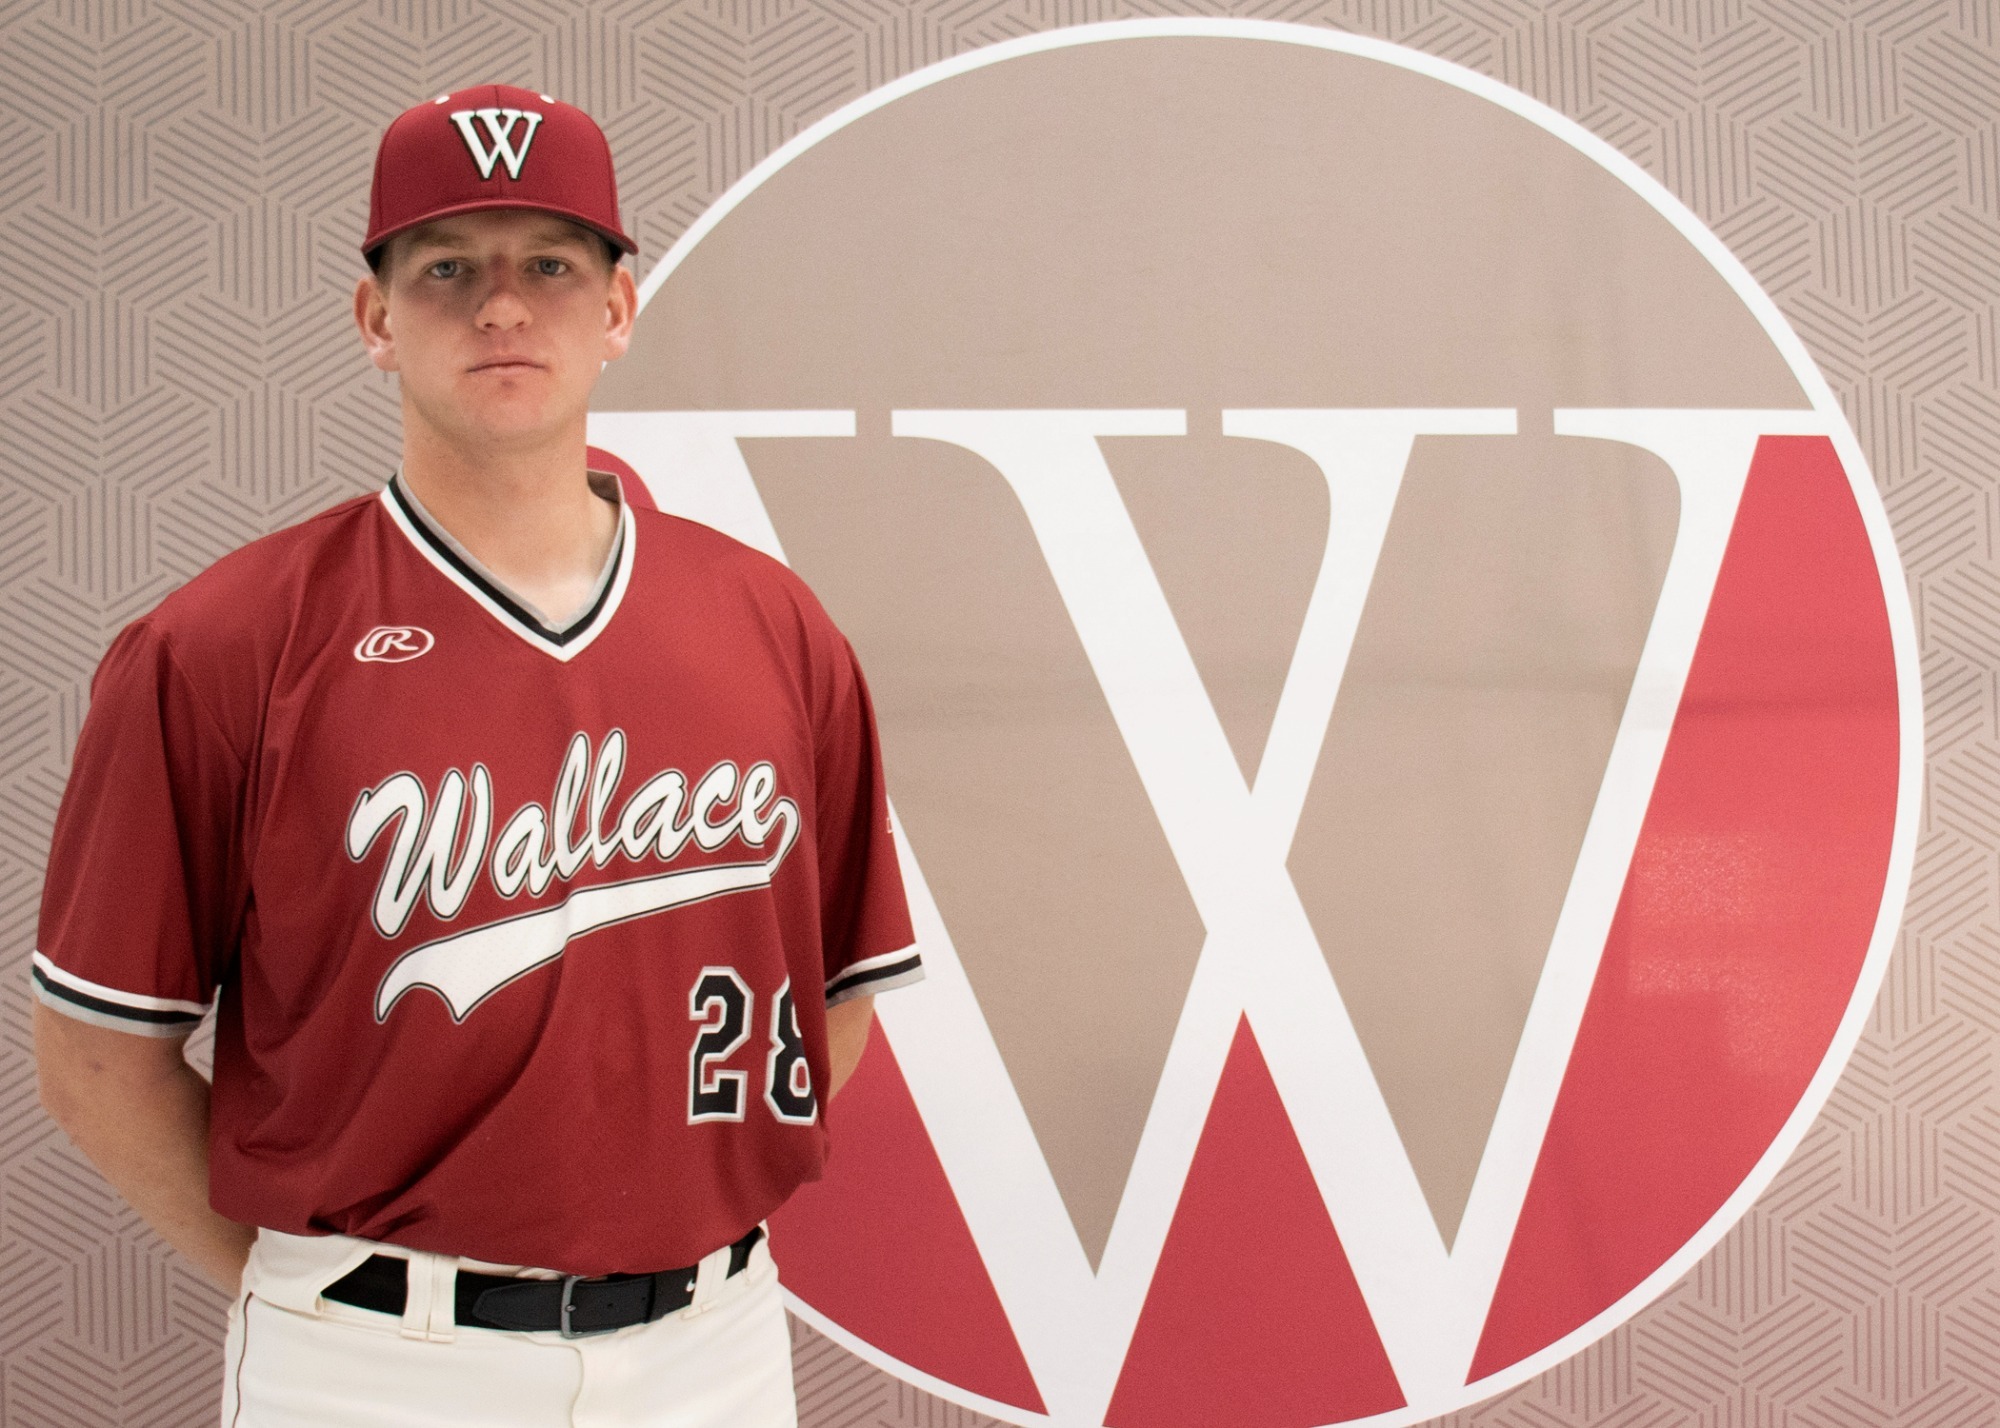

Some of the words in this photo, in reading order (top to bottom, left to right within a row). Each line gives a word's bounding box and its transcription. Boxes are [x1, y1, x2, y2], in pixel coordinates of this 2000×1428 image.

[450, 108, 543, 180] W
[364, 628, 420, 658] R
[346, 727, 800, 939] Wallace
[588, 408, 1832, 1428] W
[687, 965, 819, 1126] 28
